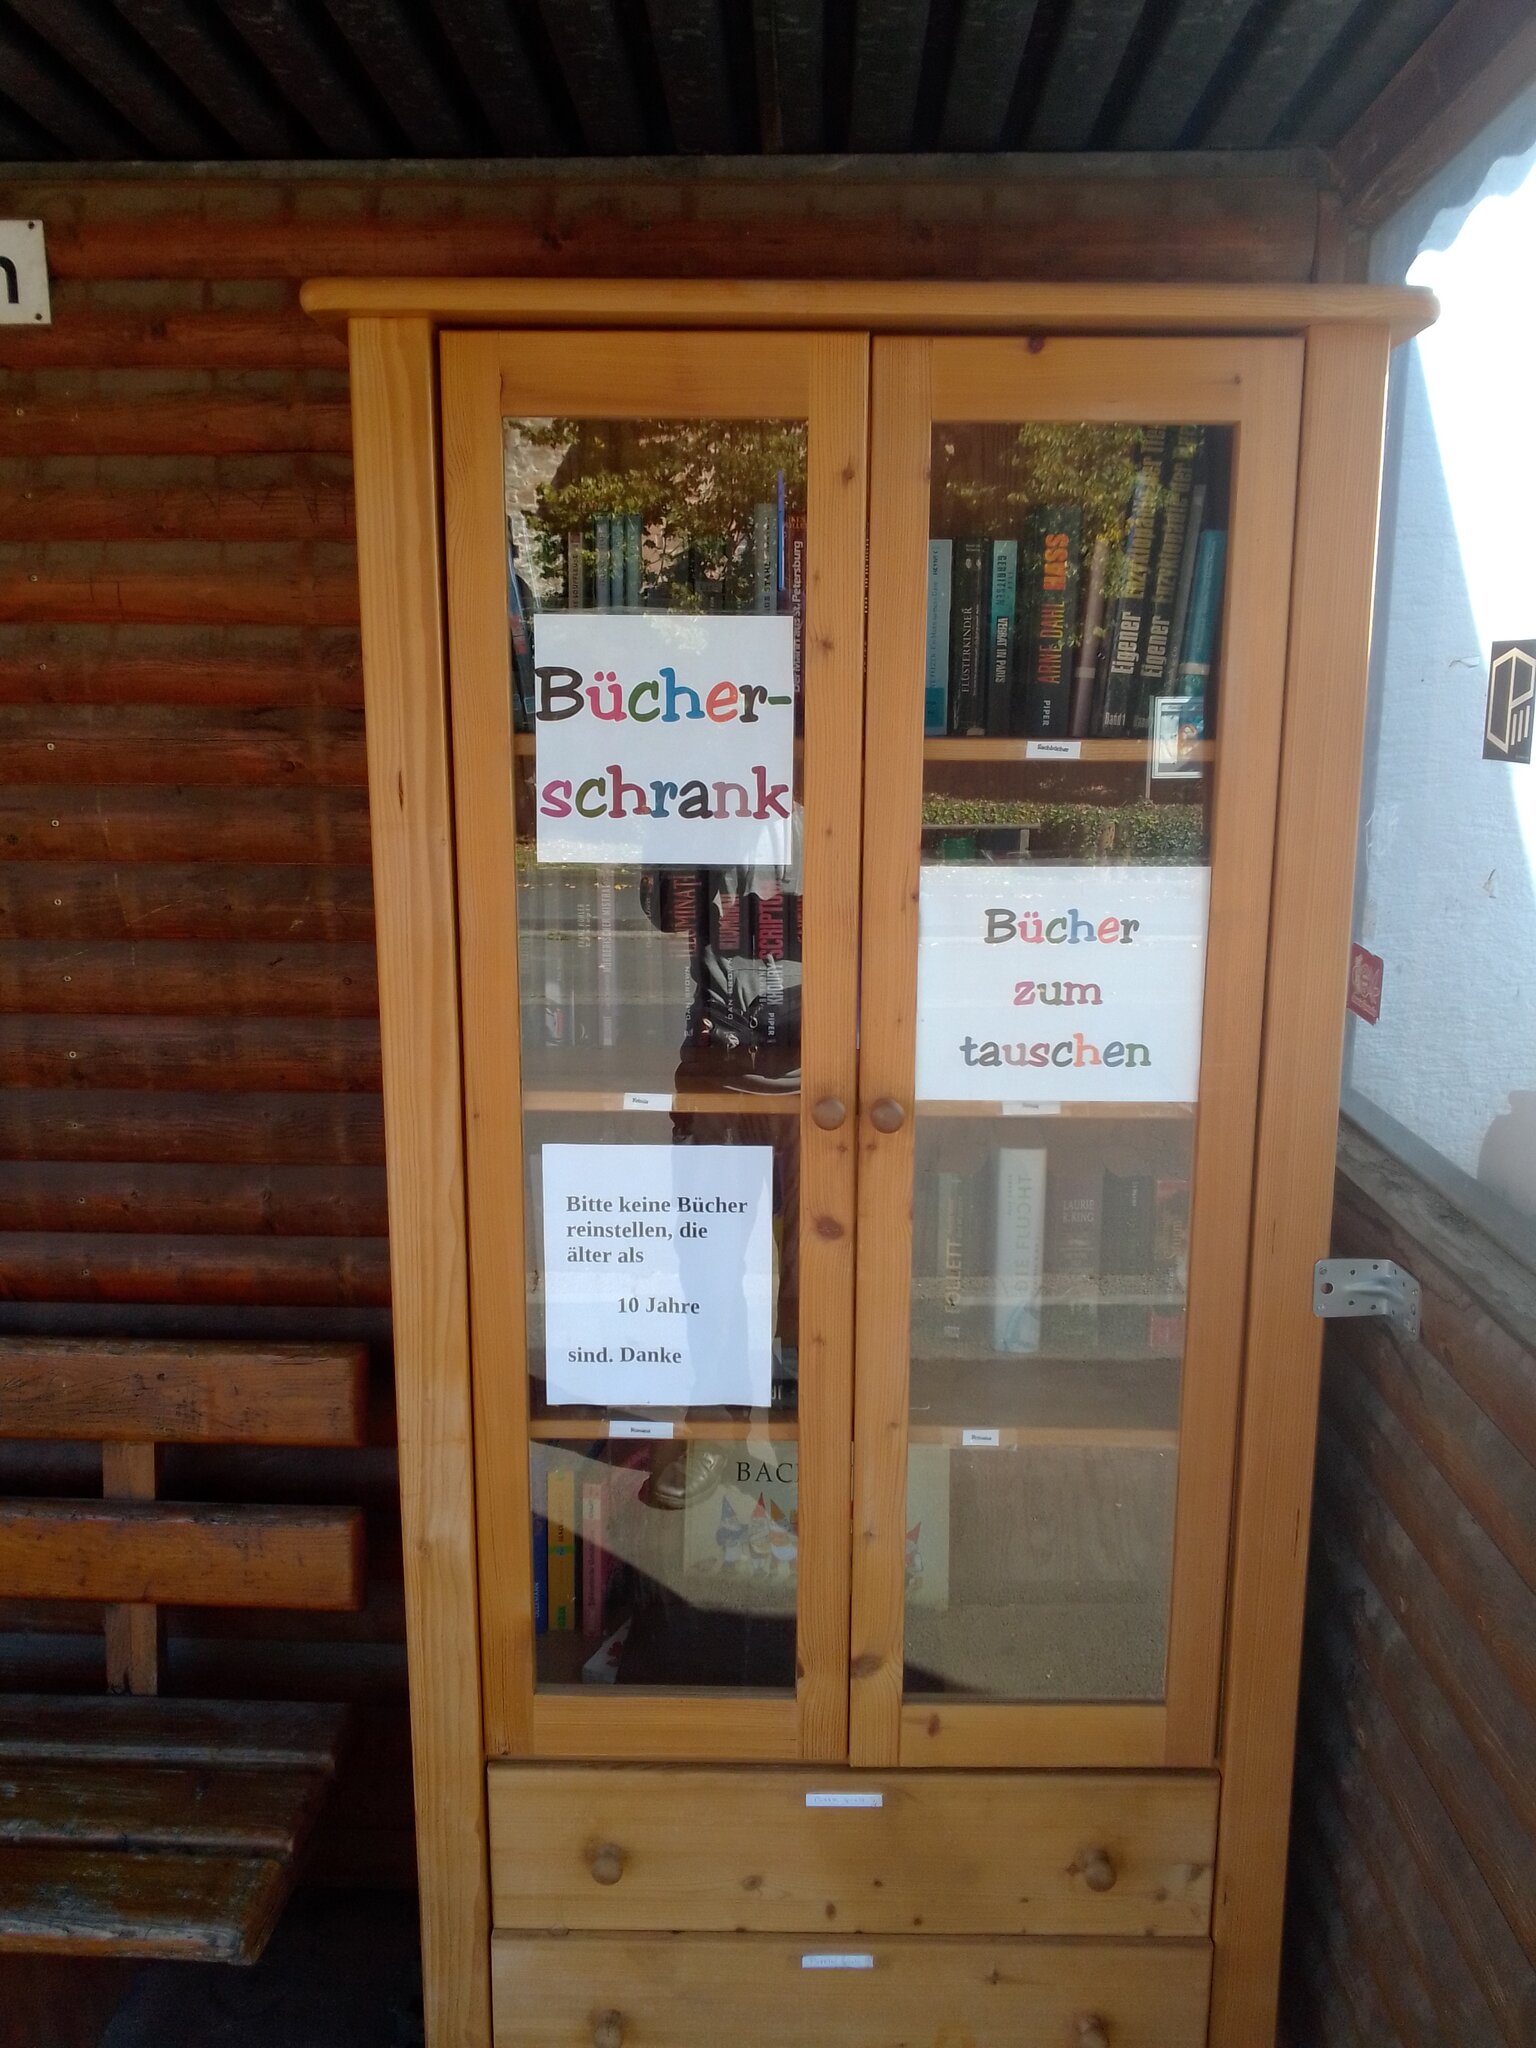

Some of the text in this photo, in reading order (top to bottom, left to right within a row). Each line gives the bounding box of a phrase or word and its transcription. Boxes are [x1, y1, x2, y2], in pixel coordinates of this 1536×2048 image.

[792, 541, 803, 603] Petersburg
[1043, 533, 1070, 591] HASS
[1037, 601, 1066, 684] ARNE DAHL
[1111, 611, 1141, 675] Eigener
[1140, 615, 1170, 678] Eigener
[534, 666, 792, 723] Bücher-
[1042, 700, 1051, 726] PIPER
[540, 764, 790, 819] schrank
[984, 908, 1139, 944] Bücher
[767, 963, 784, 1005] KHOURY
[1013, 981, 1103, 1006] zum
[959, 1032, 1152, 1068] tauschen
[566, 1196, 748, 1214] Bitte keine Bücher
[566, 1222, 708, 1240] reinstellen, die
[567, 1247, 644, 1263] älter als
[618, 1297, 700, 1315] 10 Jahre
[568, 1347, 682, 1364] sind. Danke
[736, 1461, 799, 1484] BAC
